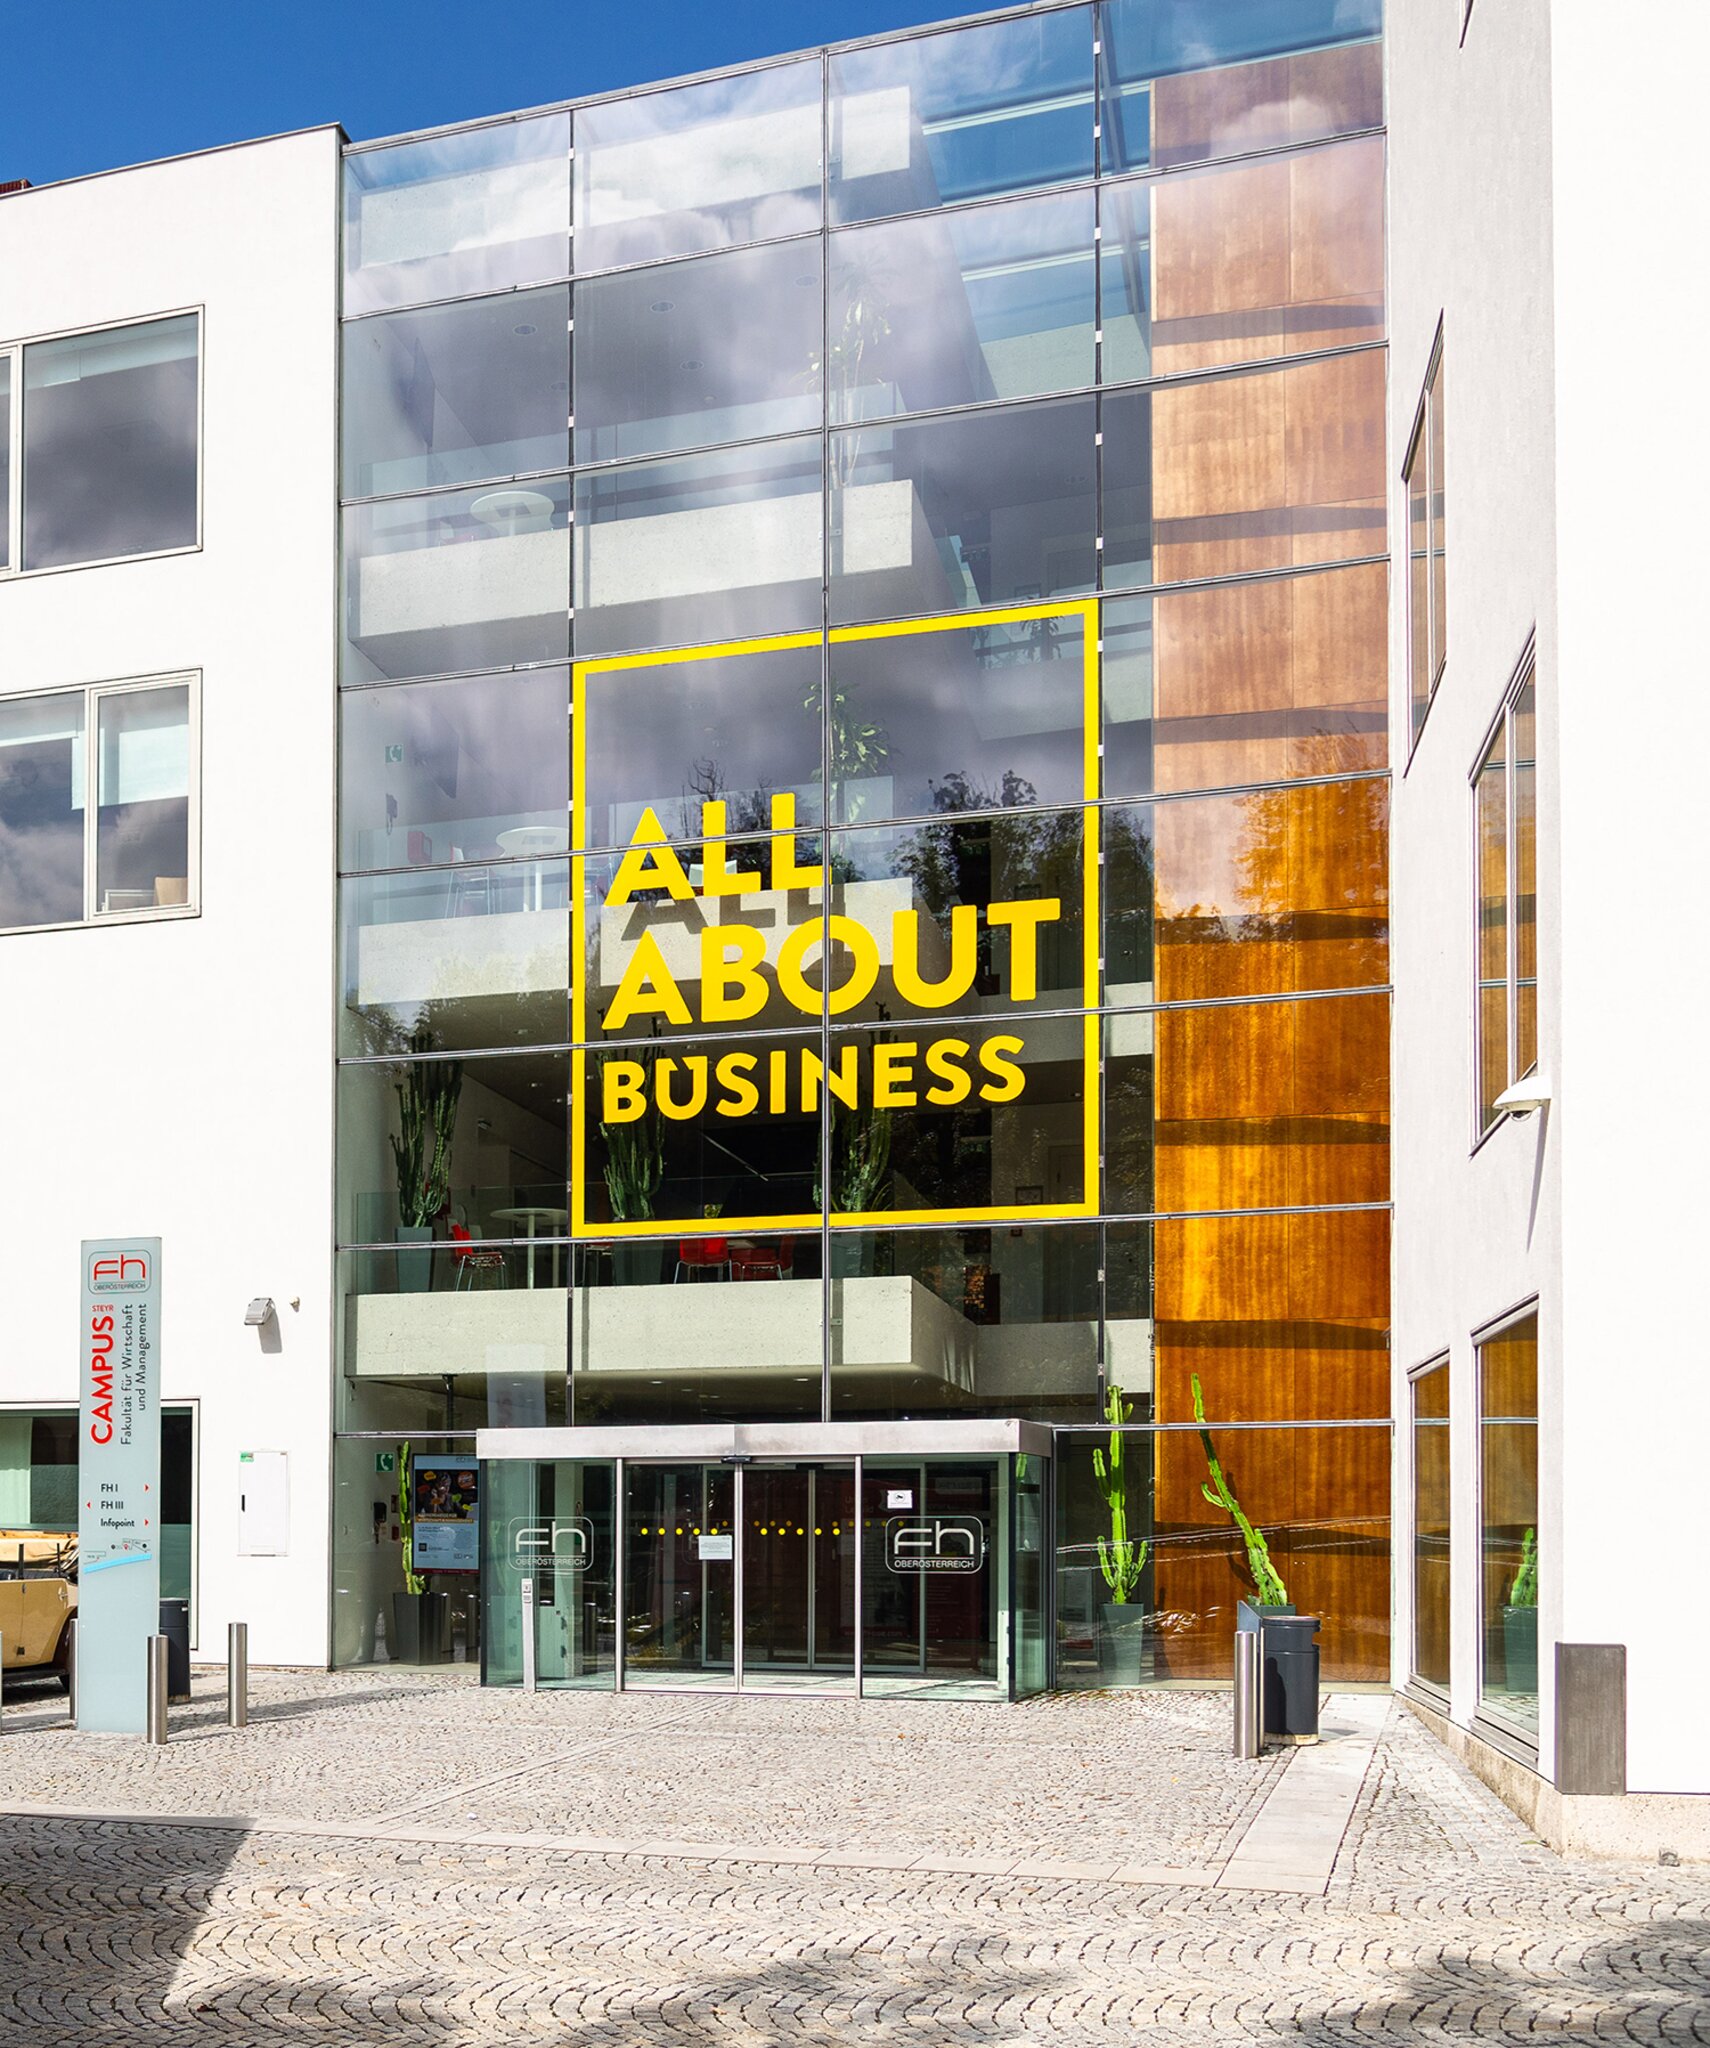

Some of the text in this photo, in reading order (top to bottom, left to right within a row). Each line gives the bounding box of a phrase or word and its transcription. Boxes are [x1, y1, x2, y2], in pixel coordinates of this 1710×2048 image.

[604, 792, 831, 906] ALL
[602, 897, 1061, 1030] ABOUT
[603, 1034, 1026, 1124] BUSINESS
[91, 1304, 114, 1312] STEYR
[135, 1303, 151, 1411] und Management
[91, 1315, 114, 1444] CAMPUS
[120, 1304, 133, 1445] Fakultät für Wirtschaft
[101, 1483, 113, 1492] FH
[101, 1501, 124, 1509] FH III
[101, 1518, 135, 1529] Infopoint
